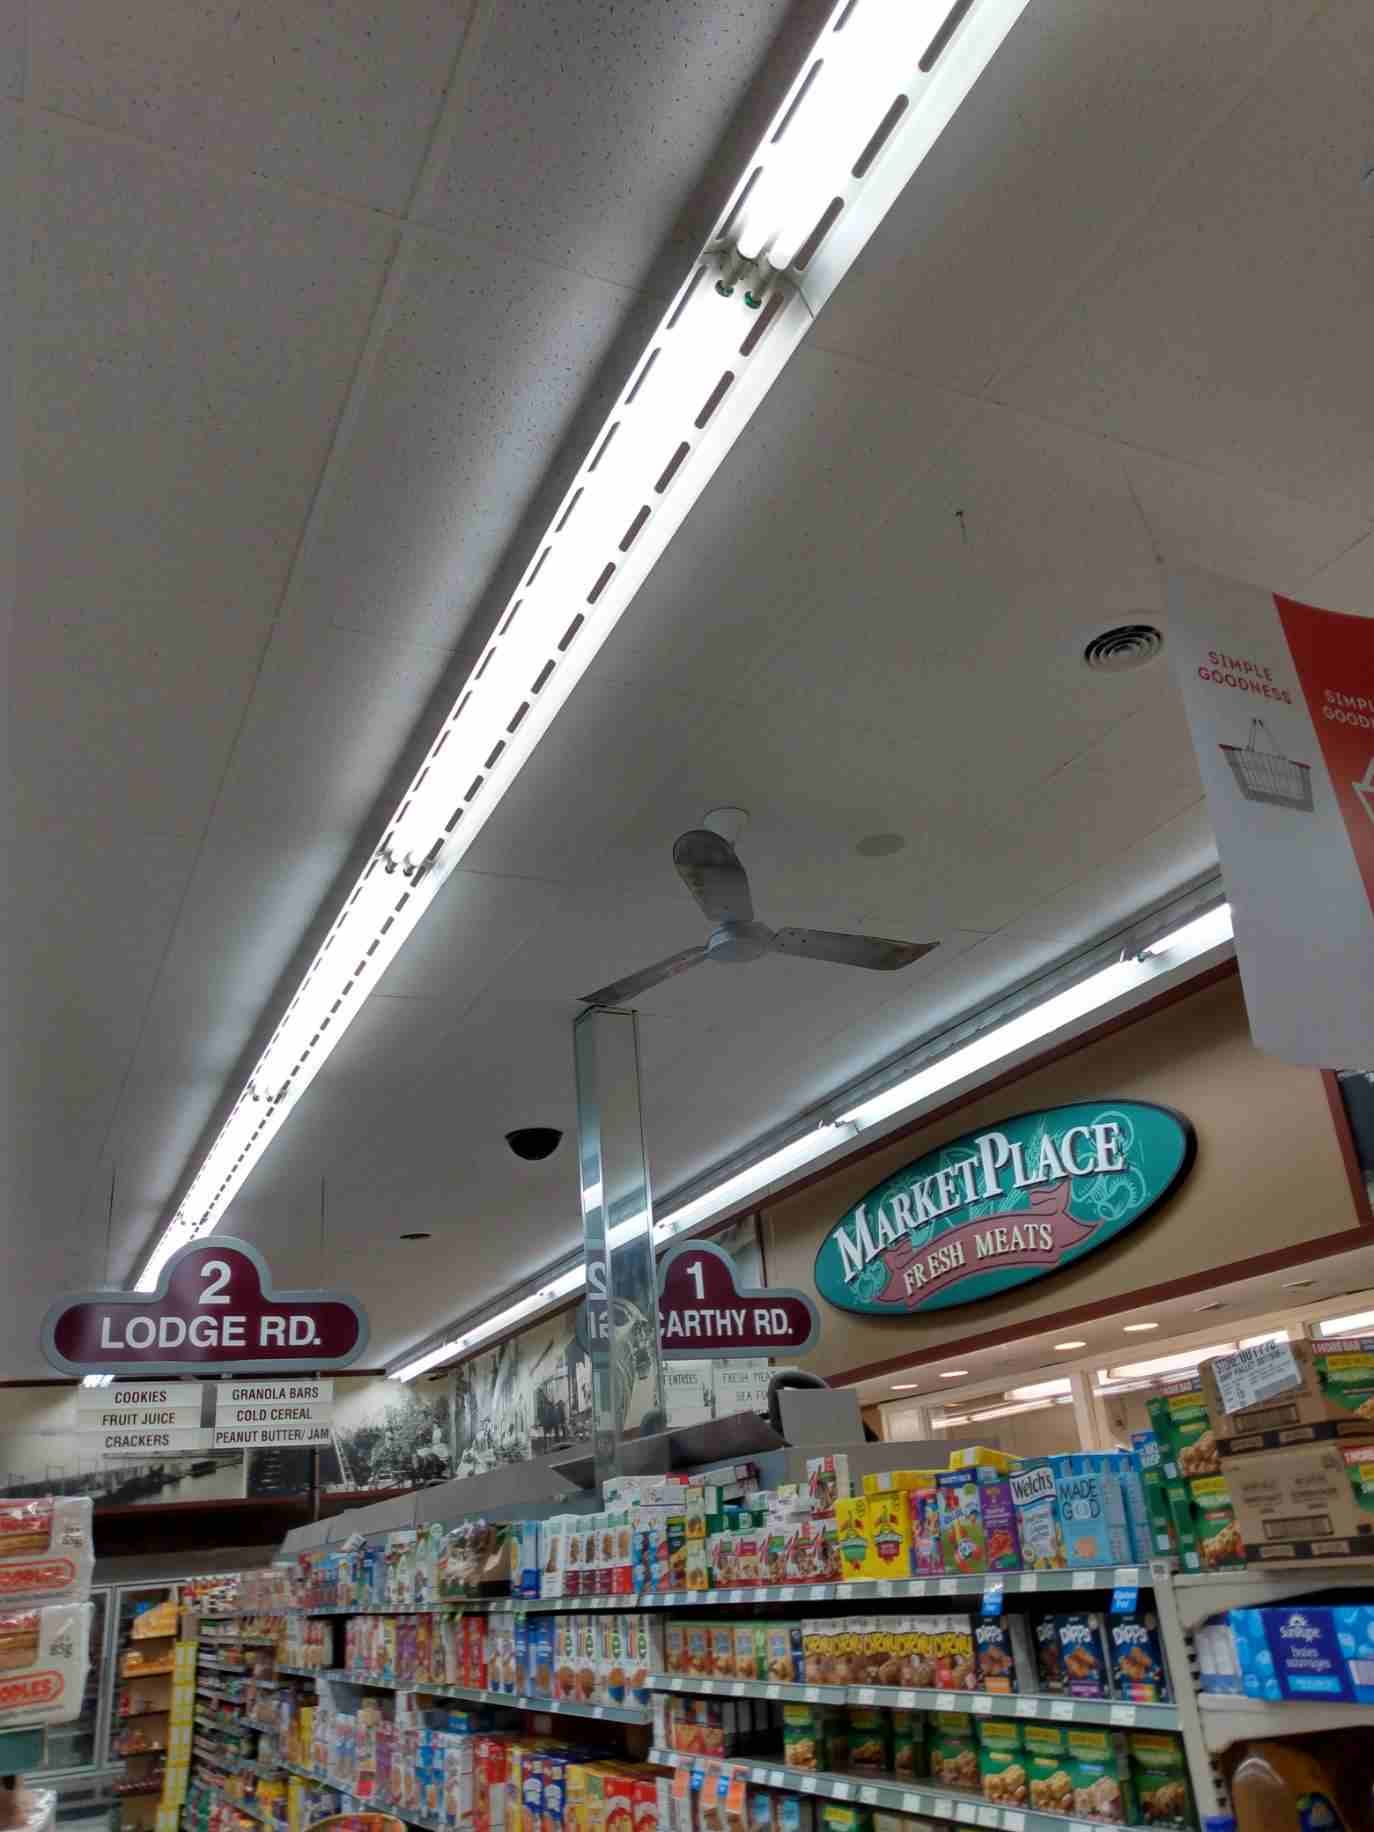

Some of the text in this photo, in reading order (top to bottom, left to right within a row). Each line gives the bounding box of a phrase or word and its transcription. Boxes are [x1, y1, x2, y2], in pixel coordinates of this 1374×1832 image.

[1208, 651, 1273, 682] SIMPLE
[1198, 667, 1293, 705] GOODNESS
[903, 1223, 1054, 1297] FRESH MEATS
[198, 1260, 232, 1305] 2
[686, 1261, 705, 1300] 1
[100, 1314, 322, 1350] LODGE RD.
[753, 1308, 794, 1336] RD.
[114, 1390, 167, 1404] COOKIES
[232, 1387, 320, 1402] GRANOLA BARS
[102, 1411, 176, 1426] FRUIT JUICE
[236, 1407, 313, 1422] COLD CEREAL
[105, 1433, 170, 1448] CRACKERS
[215, 1430, 259, 1444] PEANUT
[1059, 1478, 1098, 1499] MADE
[1062, 1498, 1102, 1521] GOOD
